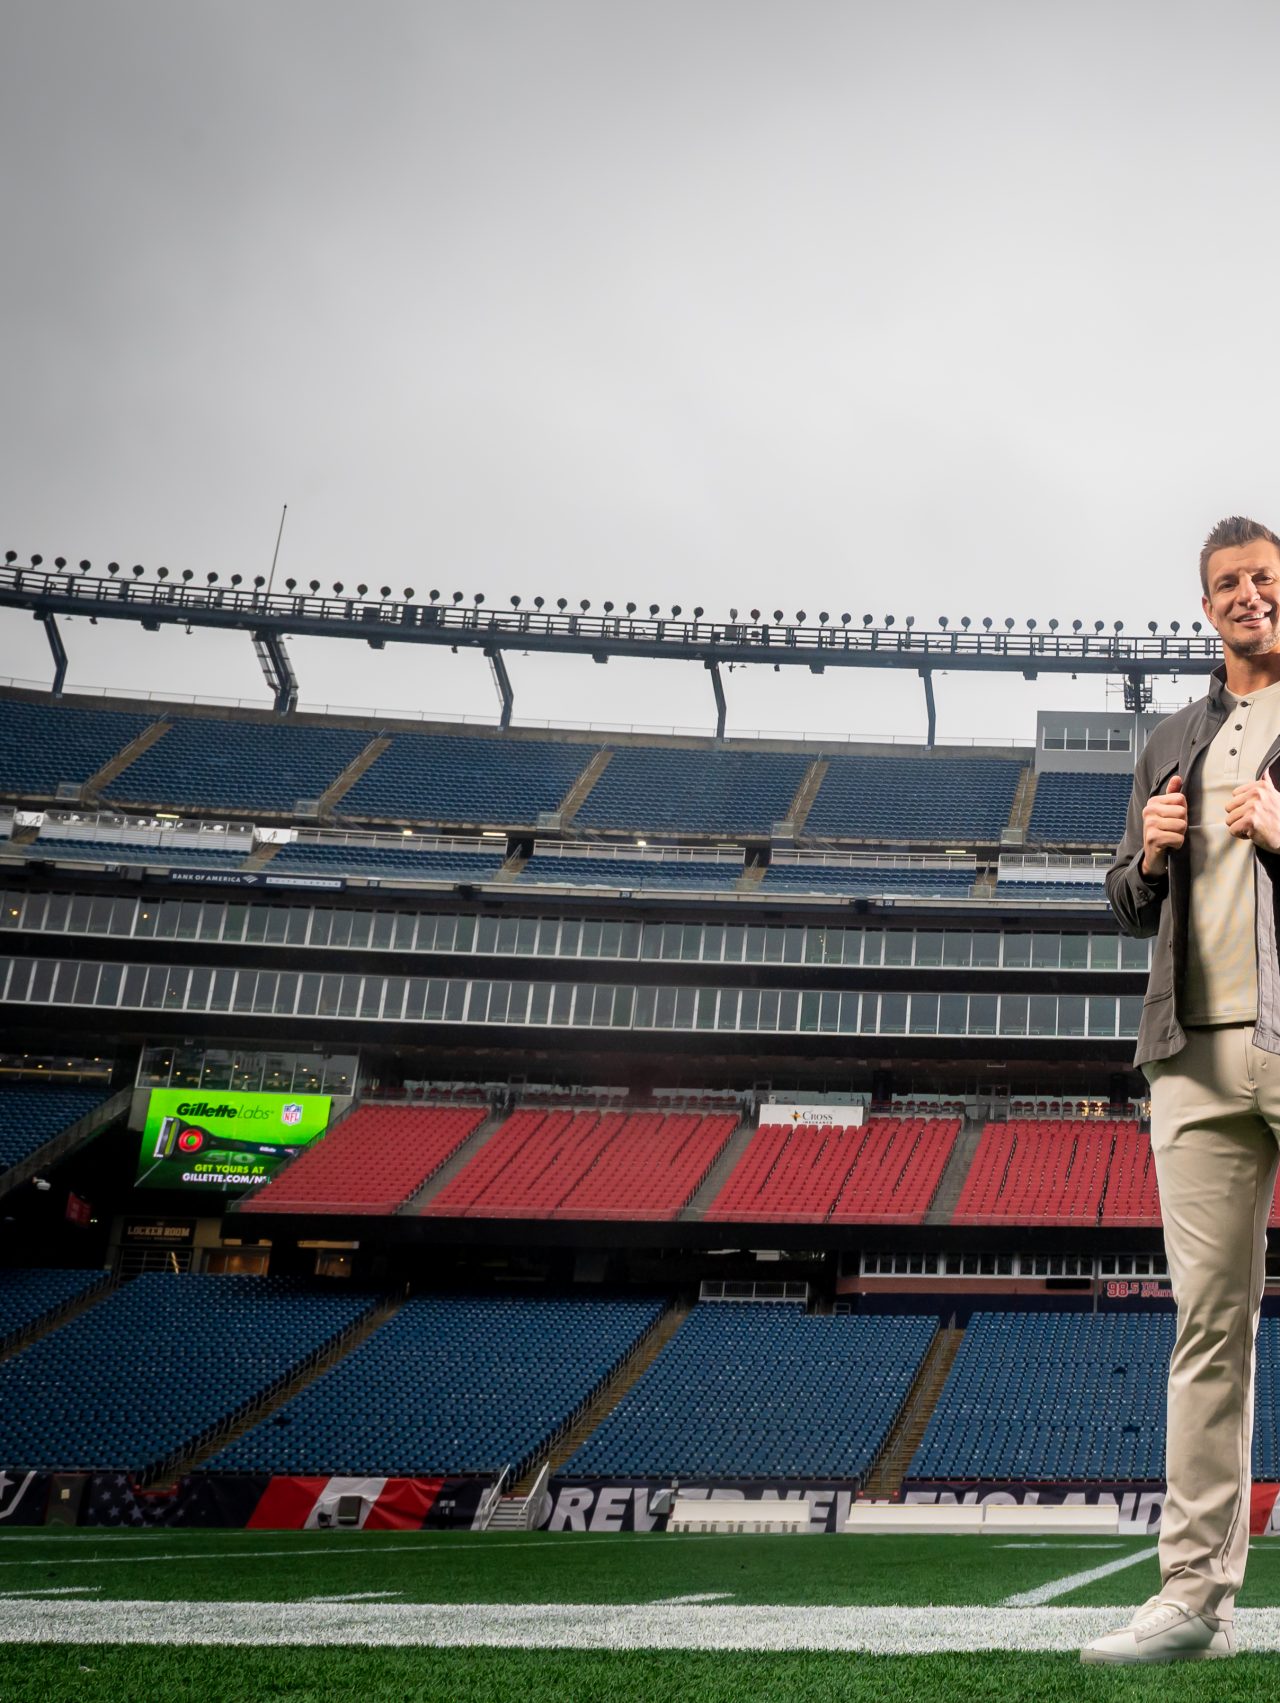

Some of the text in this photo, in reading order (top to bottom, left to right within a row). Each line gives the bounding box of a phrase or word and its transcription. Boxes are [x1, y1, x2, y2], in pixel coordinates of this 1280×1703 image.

[172, 873, 194, 881] BANK
[206, 874, 241, 883] AMERICA
[283, 1111, 300, 1123] NFL
[194, 1163, 265, 1174] GET YOURS AT
[127, 1226, 190, 1237] LOCKER ROOM
[1107, 1282, 1139, 1297] 98.5
